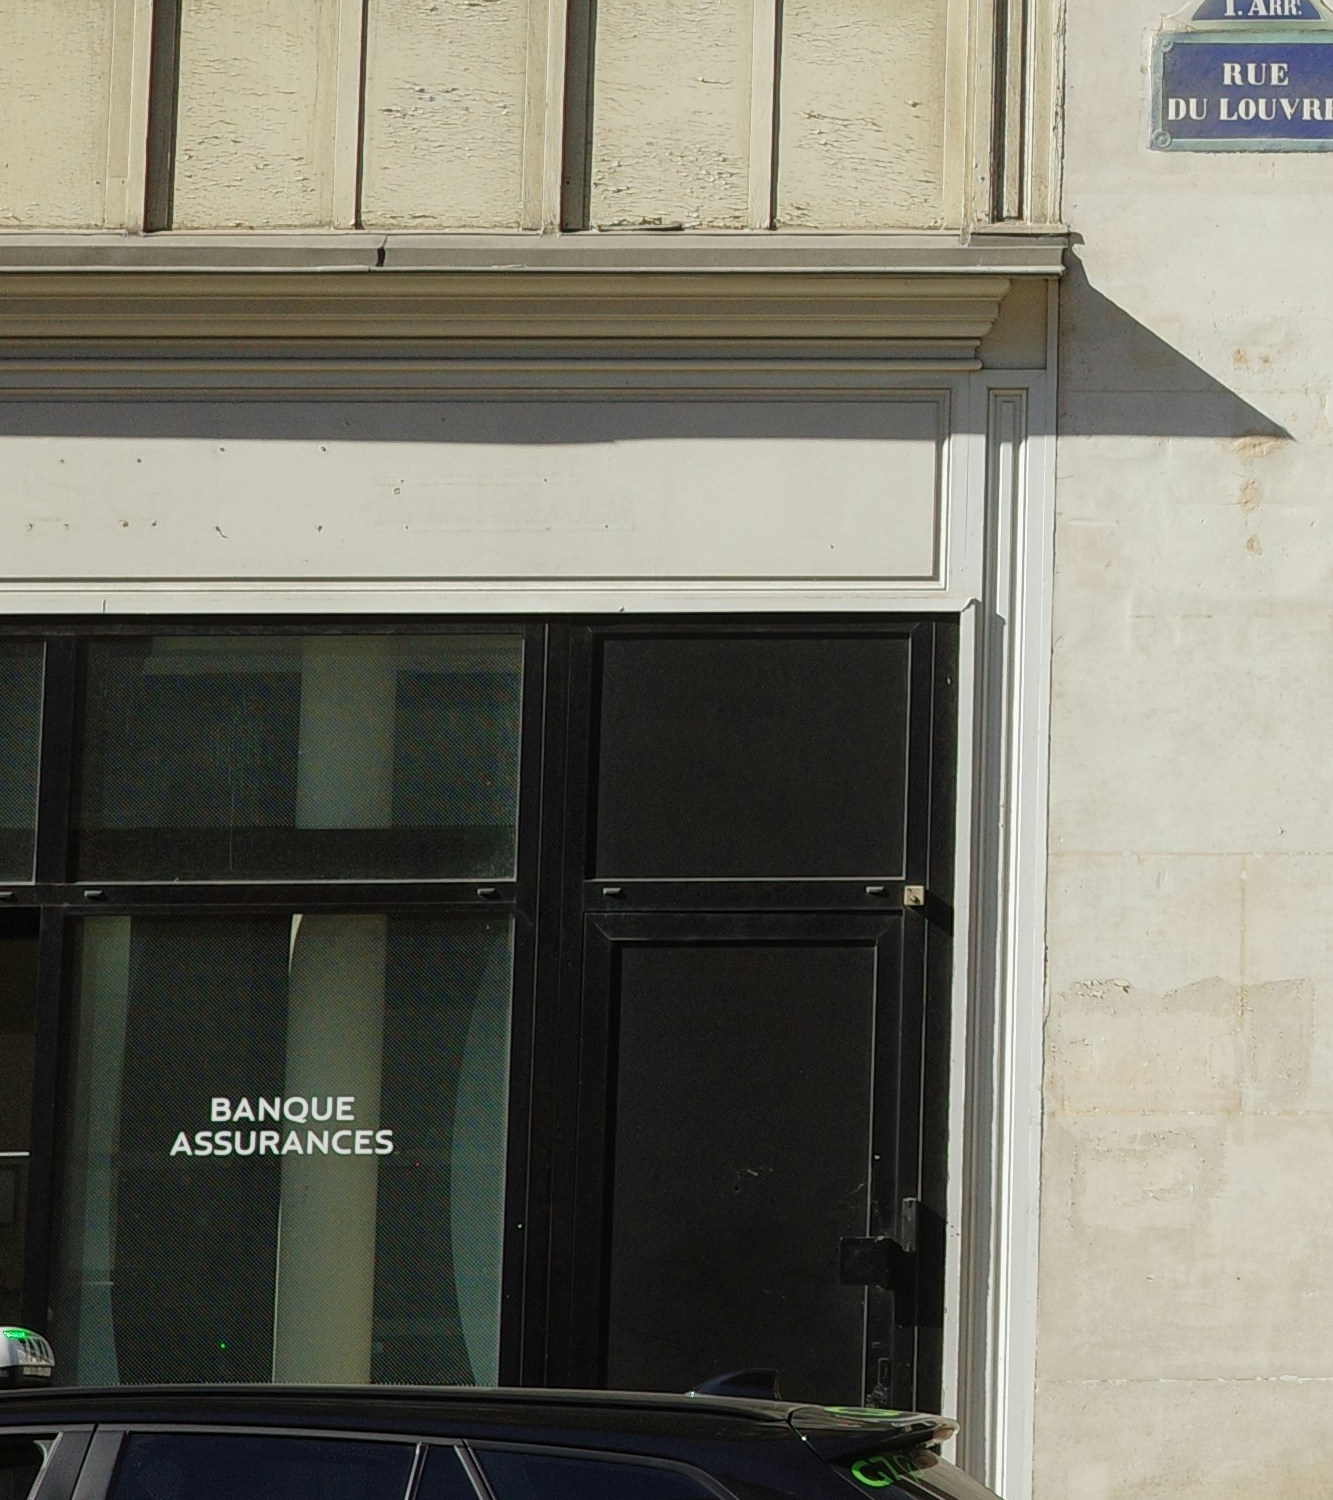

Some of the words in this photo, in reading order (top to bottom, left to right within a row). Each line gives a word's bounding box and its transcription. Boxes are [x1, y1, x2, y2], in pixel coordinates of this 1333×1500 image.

[1222, 62, 1289, 87] RUE
[1167, 97, 1208, 122] DU
[210, 1096, 356, 1124] BANQUE
[169, 1129, 394, 1157] ASSURANCES
